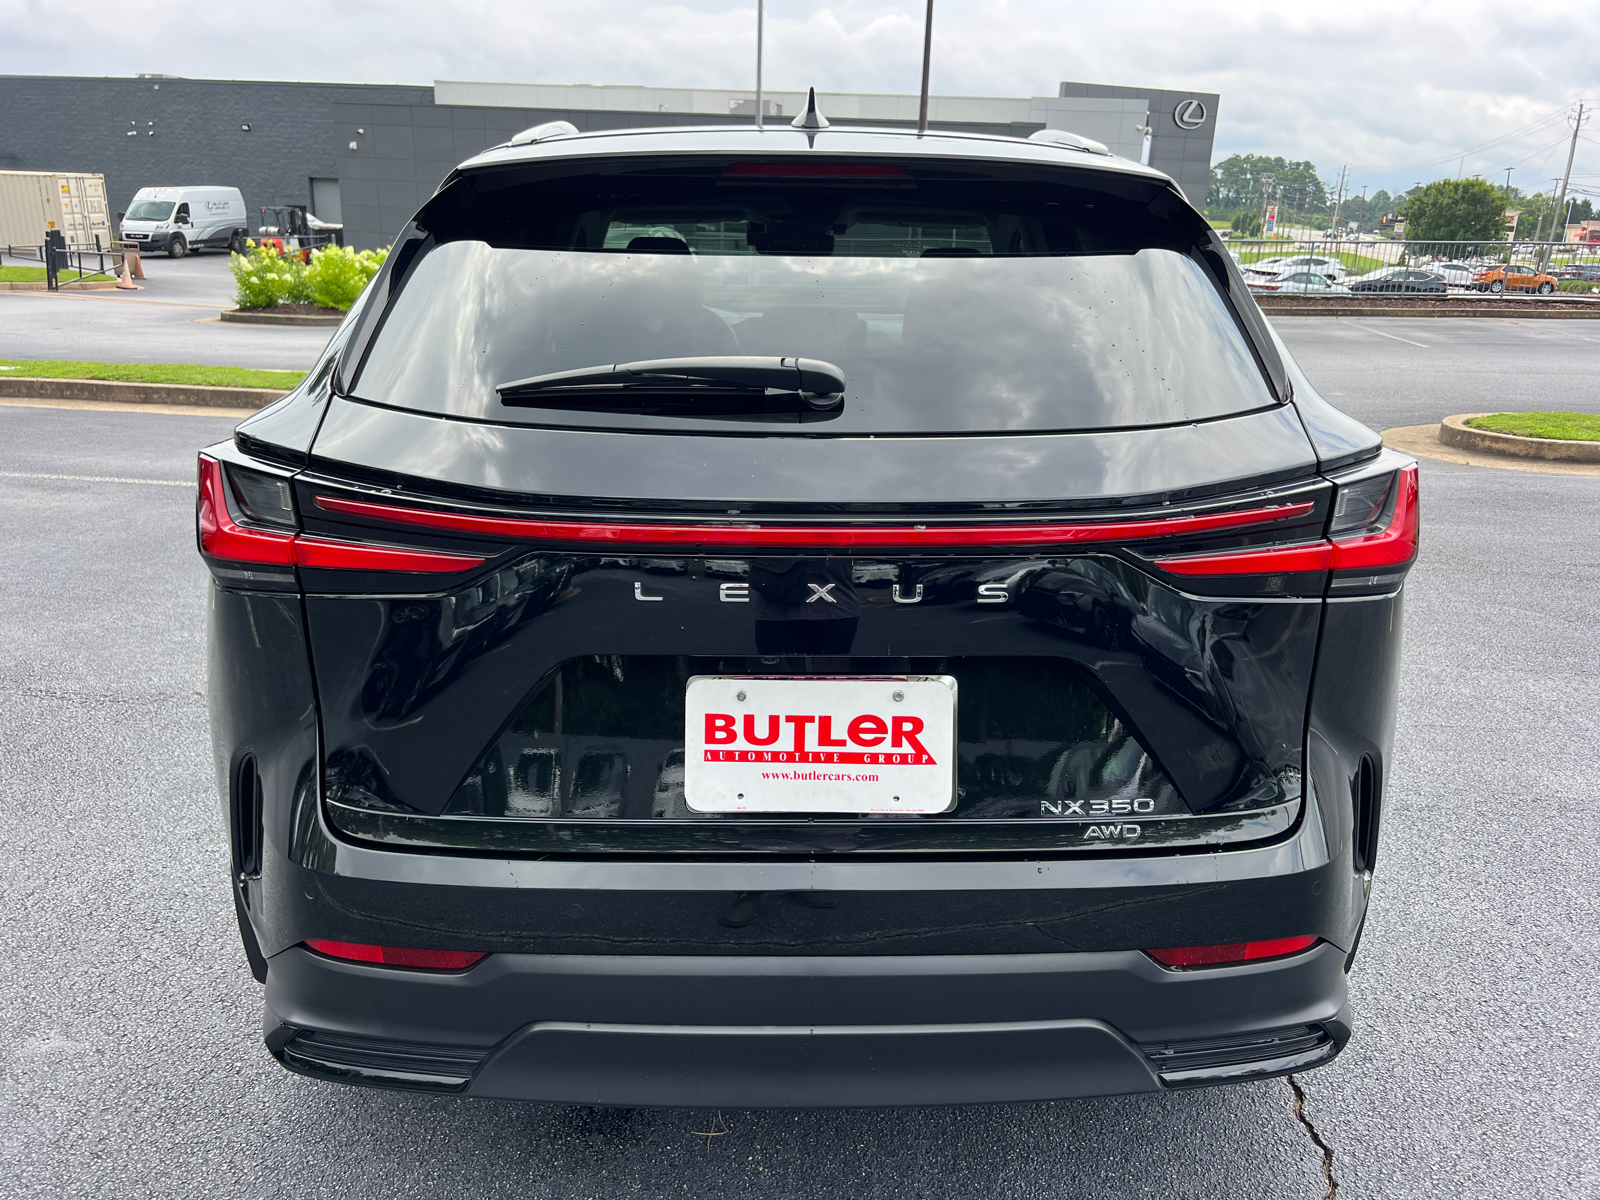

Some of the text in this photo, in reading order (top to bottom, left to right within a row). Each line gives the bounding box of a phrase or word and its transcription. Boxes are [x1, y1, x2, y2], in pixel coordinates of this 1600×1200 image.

[634, 582, 1009, 604] LEXUS
[705, 752, 929, 764] AUTOMOTIVE GROUP
[761, 770, 879, 782] www.butlercars.com
[1040, 798, 1155, 816] NX 350
[1083, 824, 1141, 839] AWD
